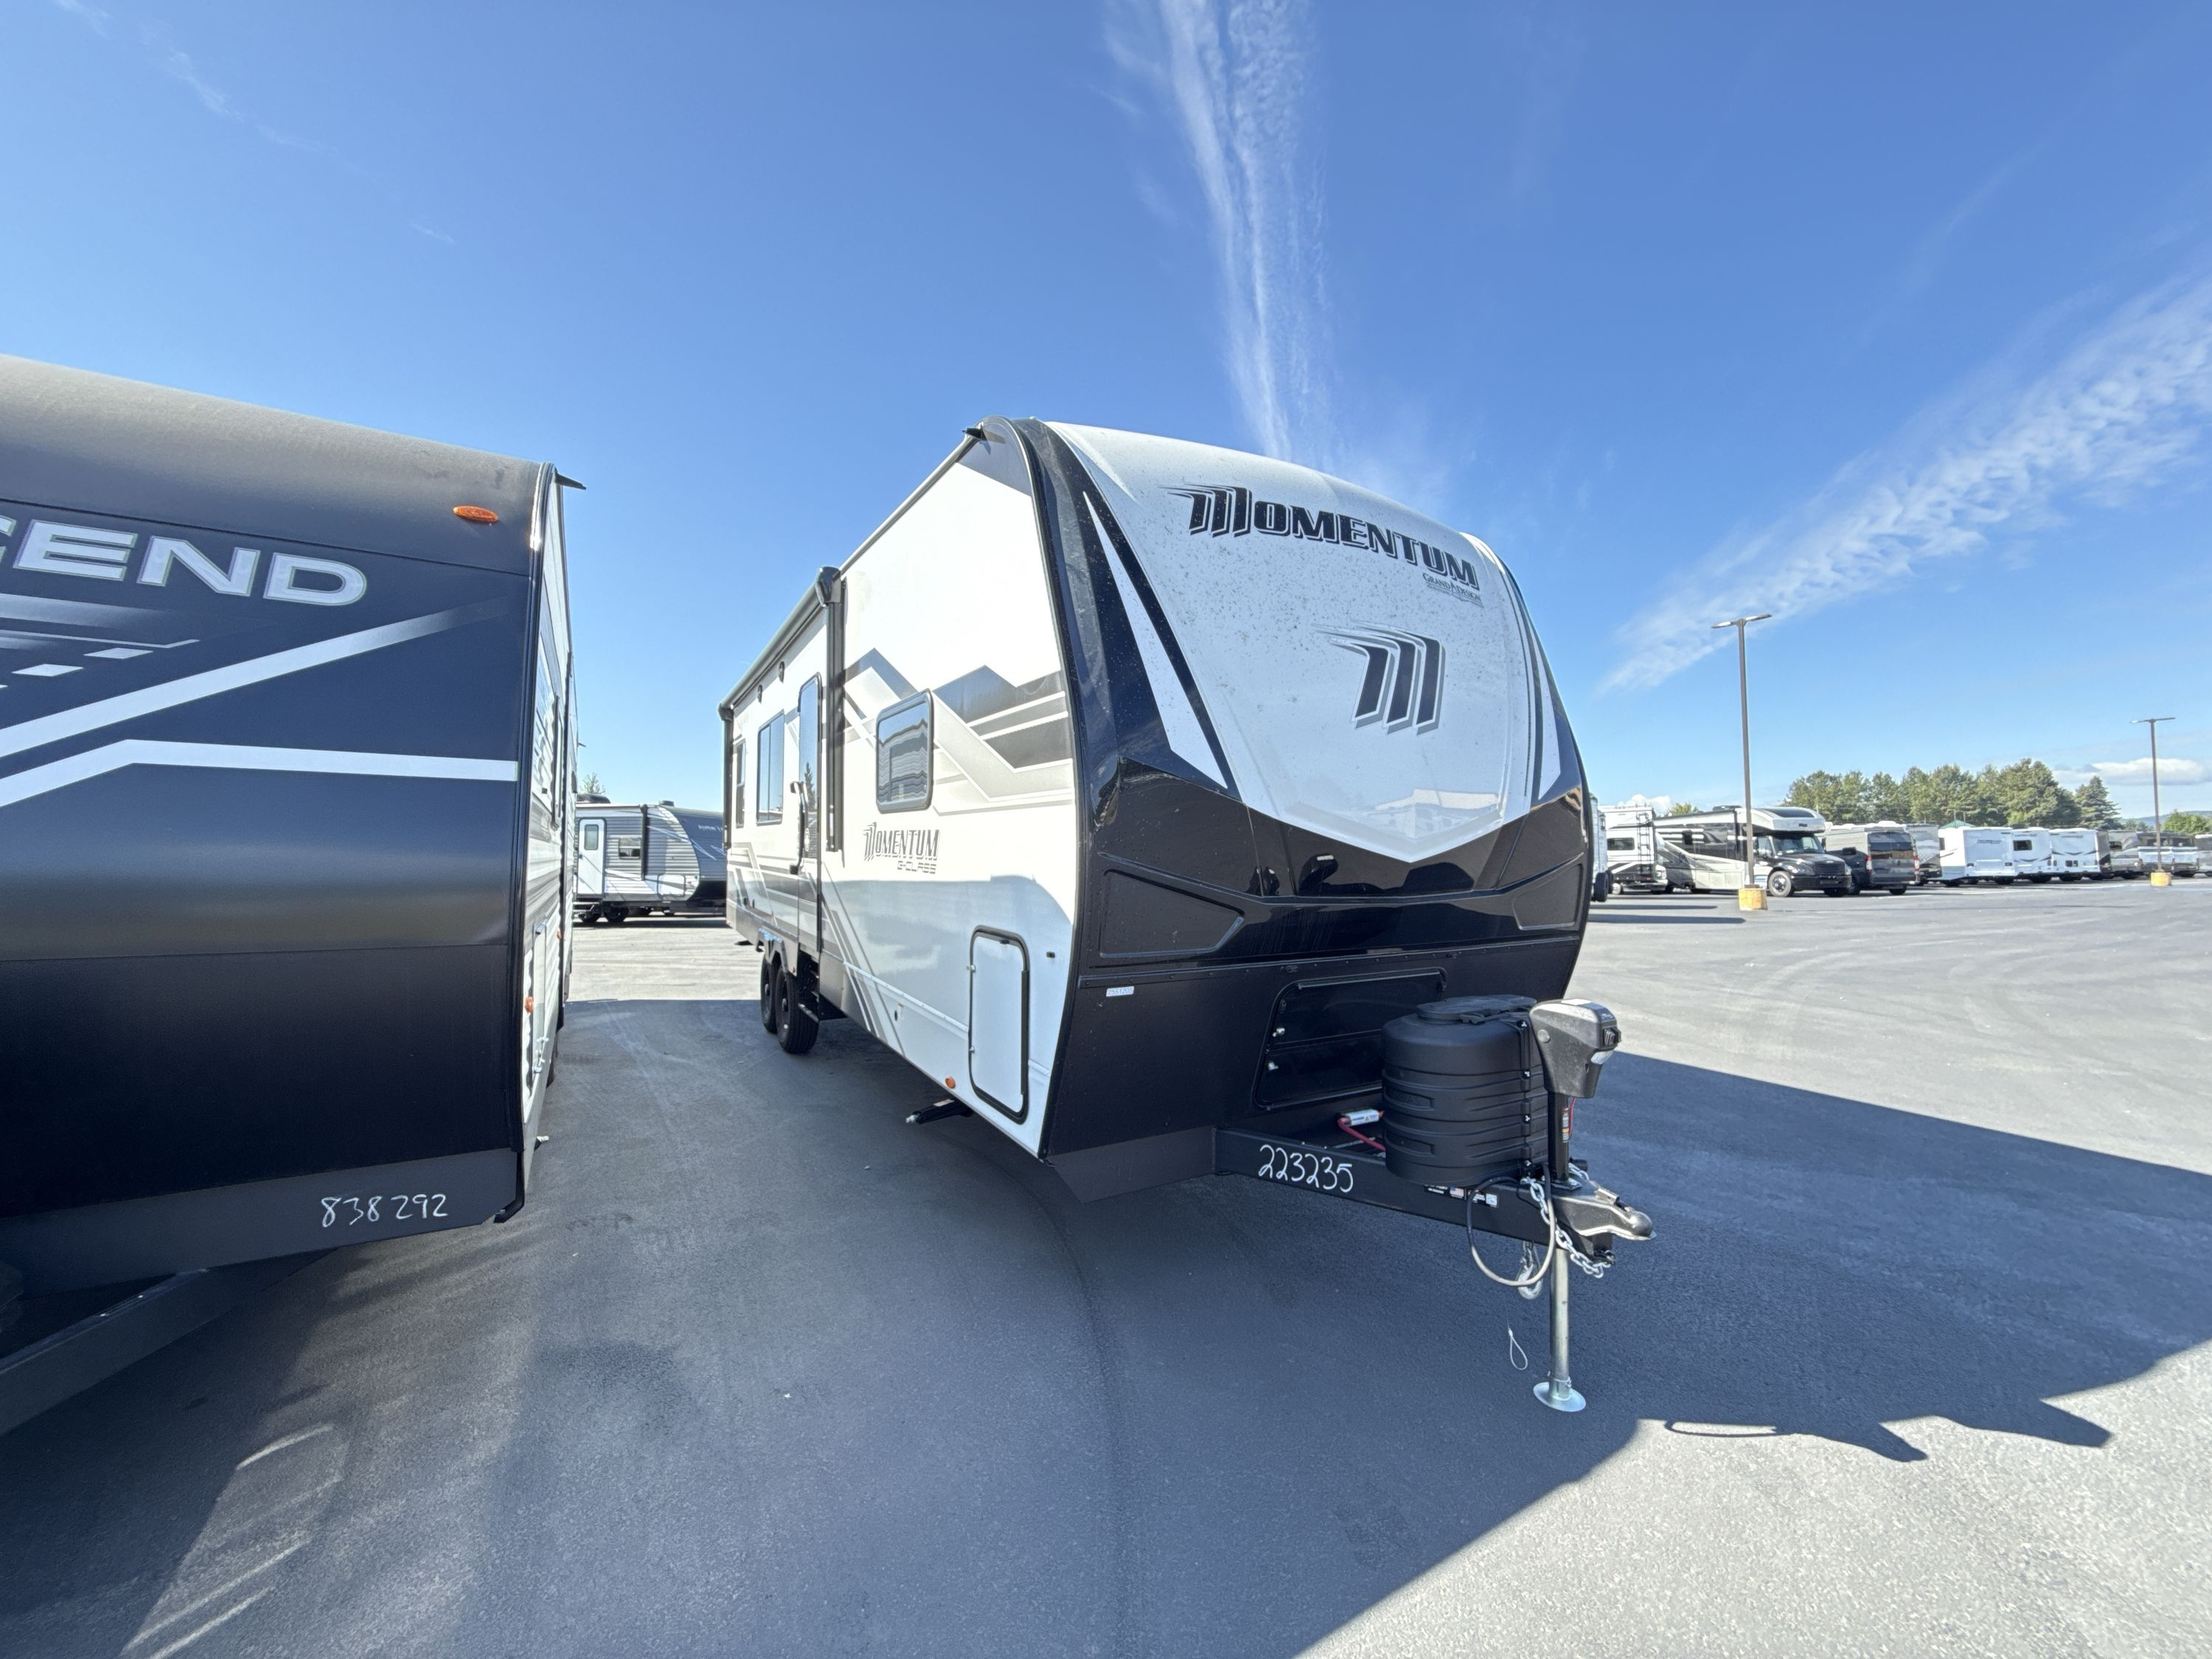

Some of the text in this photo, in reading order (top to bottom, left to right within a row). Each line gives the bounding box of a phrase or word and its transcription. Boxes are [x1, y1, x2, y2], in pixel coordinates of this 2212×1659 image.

[0, 515, 367, 606] END
[1158, 483, 1480, 591] MOMENTUM
[863, 821, 940, 861] MOMENTUM
[1258, 1144, 1354, 1192] 223235
